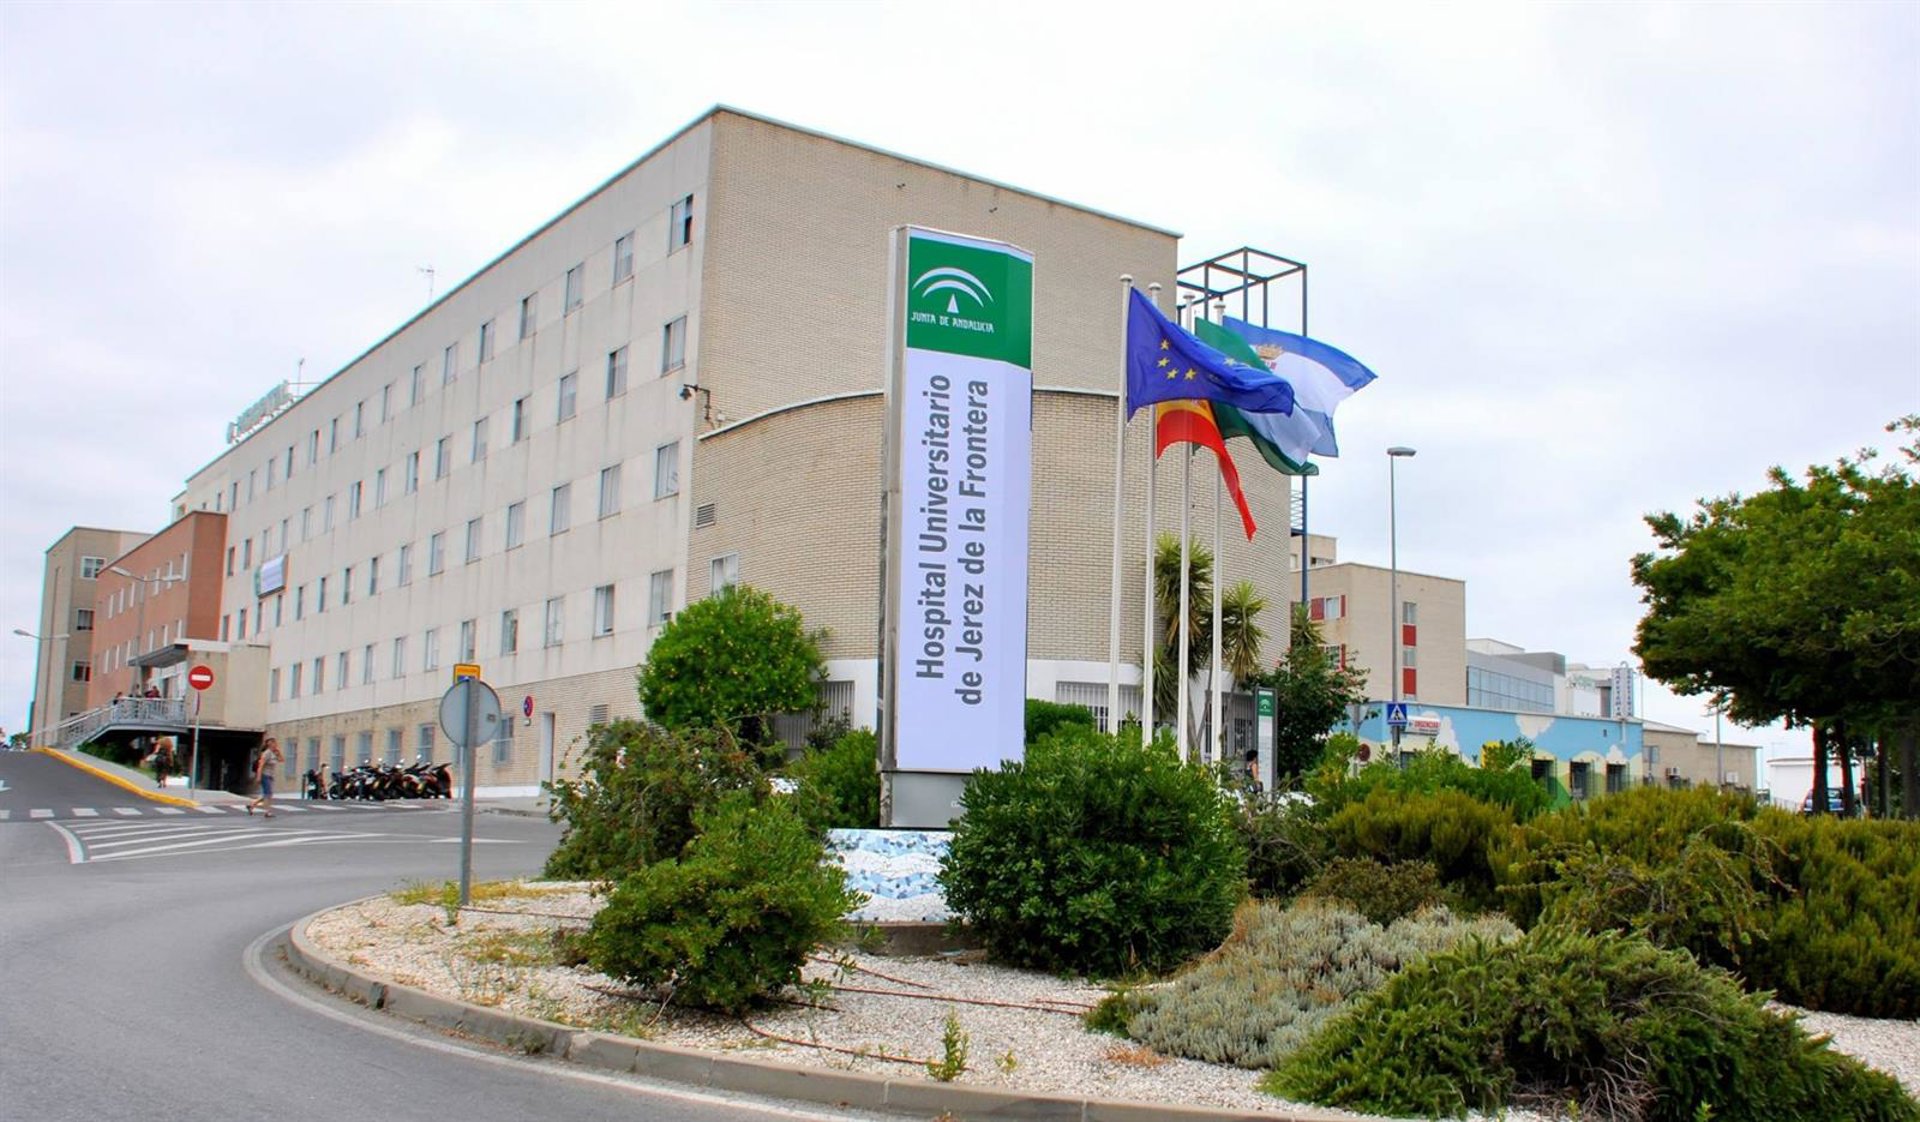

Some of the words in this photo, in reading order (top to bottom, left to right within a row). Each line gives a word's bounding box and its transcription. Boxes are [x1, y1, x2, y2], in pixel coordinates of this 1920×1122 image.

[911, 311, 936, 324] JUNTA
[939, 315, 949, 326] DE
[918, 374, 951, 552] Universitario
[958, 380, 988, 498] Frontera
[957, 507, 986, 532] la
[957, 541, 985, 575] de
[916, 562, 951, 679] Hospital
[955, 583, 984, 662] Jerez
[954, 671, 983, 705] de
